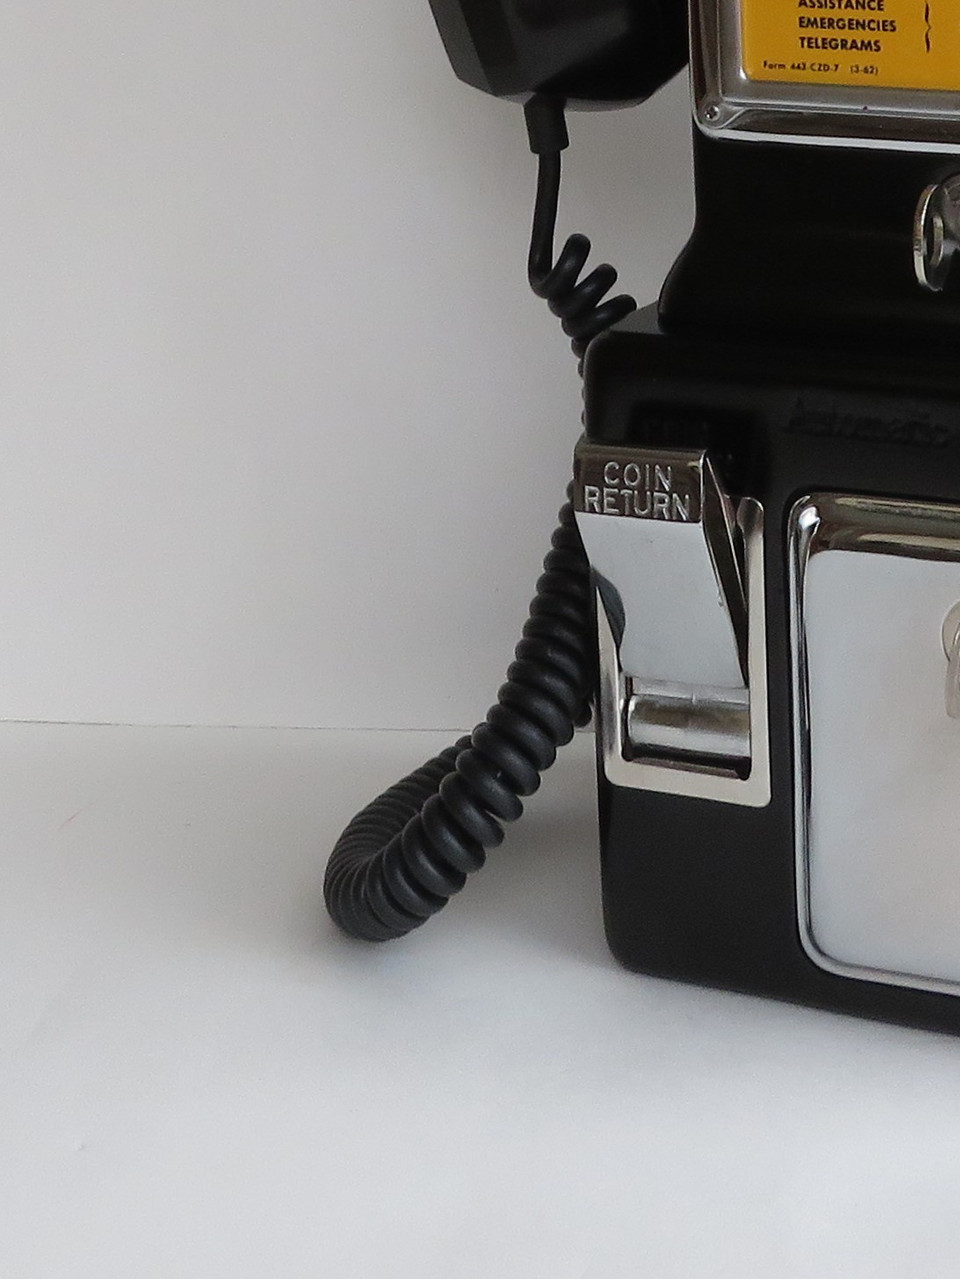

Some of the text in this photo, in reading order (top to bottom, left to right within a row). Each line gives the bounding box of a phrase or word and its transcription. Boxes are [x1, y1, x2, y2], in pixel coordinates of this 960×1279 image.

[798, 15, 897, 33] EMERGENCIES
[798, 36, 882, 53] TELEGRAMS
[763, 60, 786, 70] Form
[604, 461, 671, 491] COIN
[584, 485, 690, 521] RETURN
